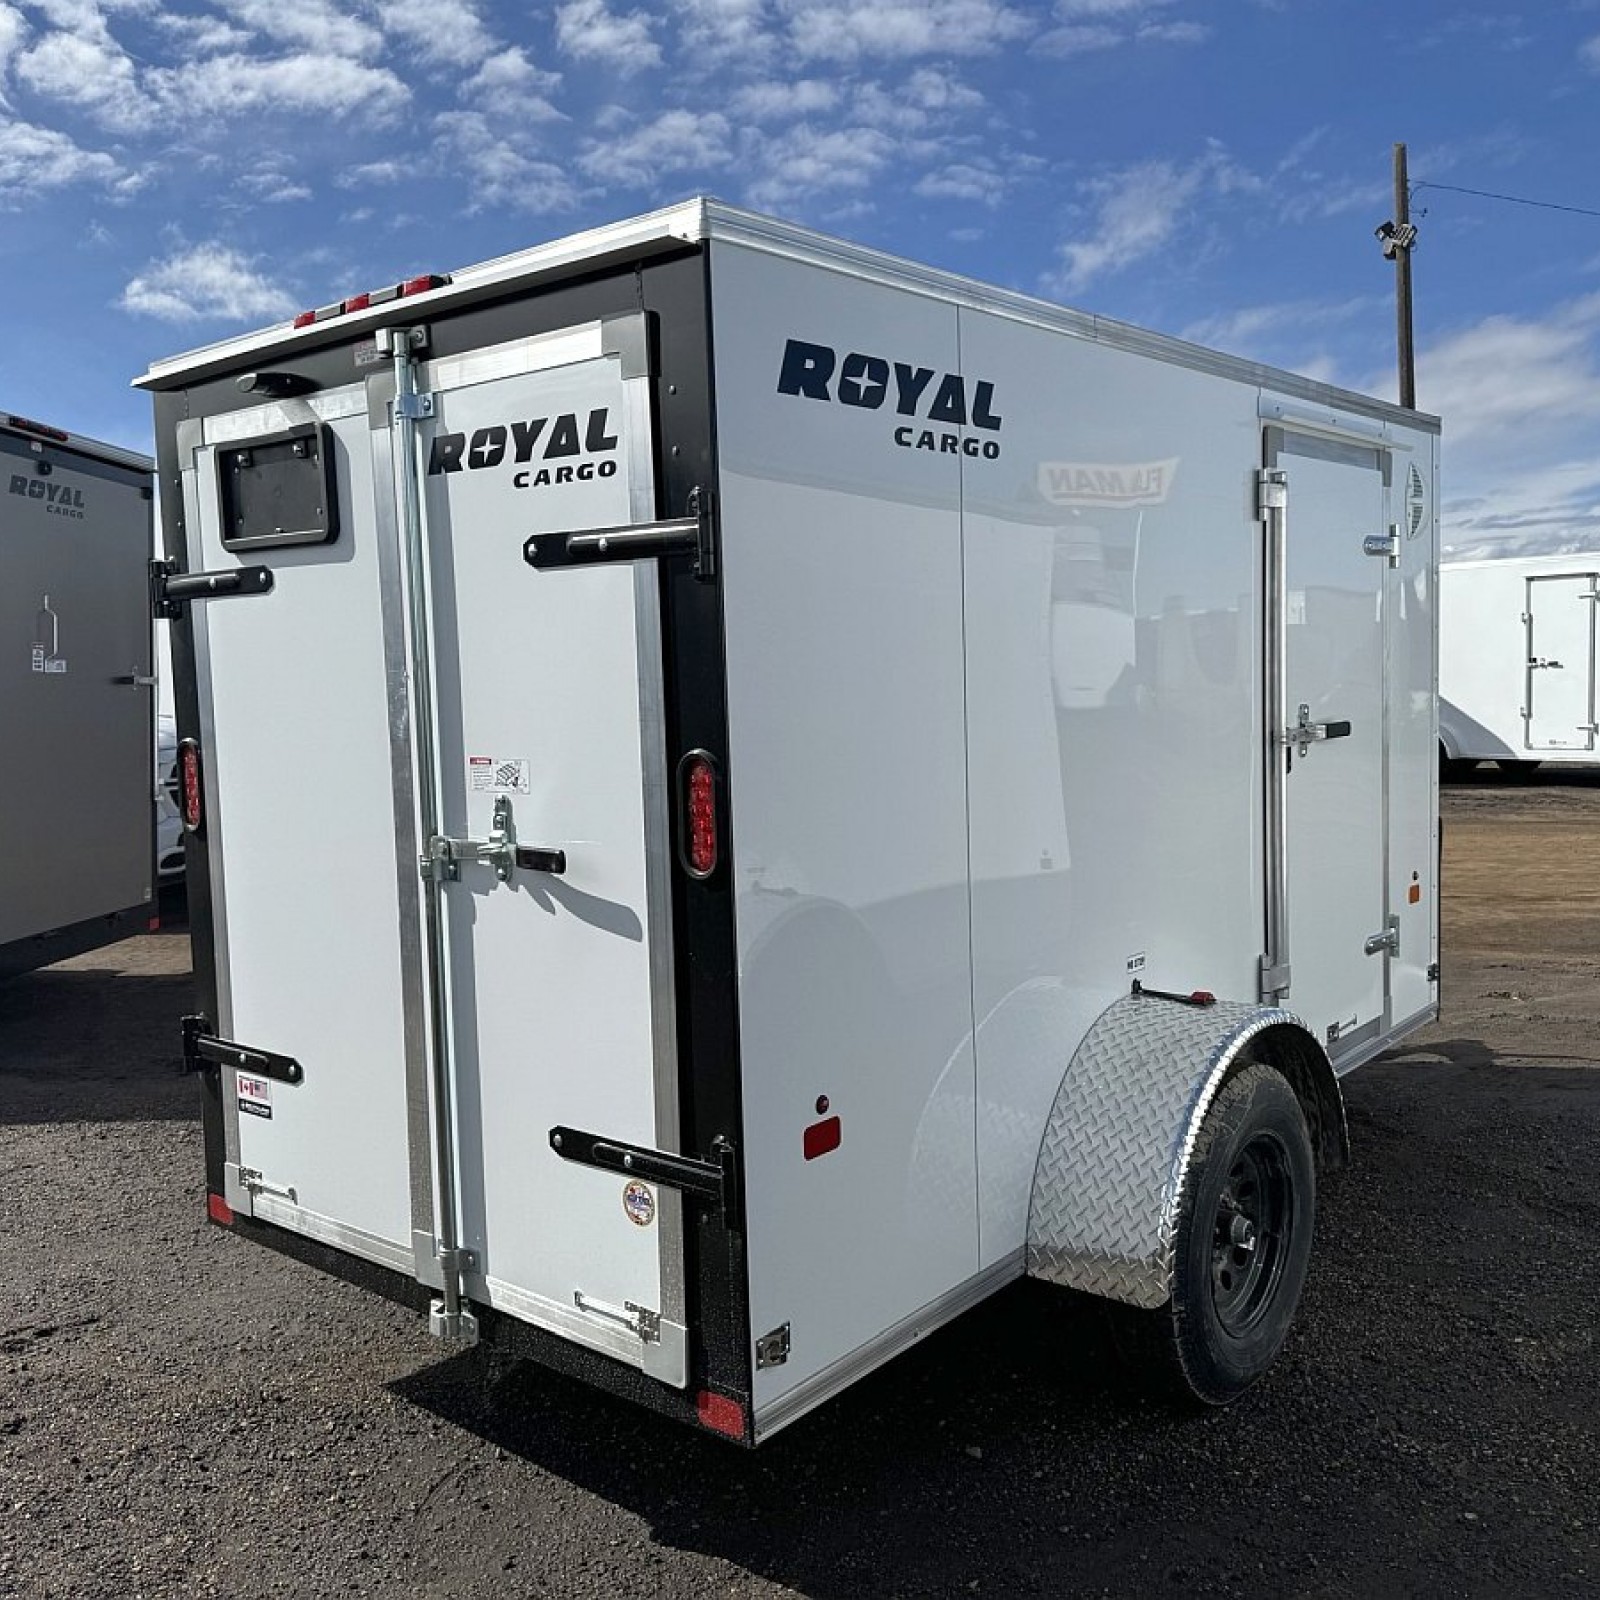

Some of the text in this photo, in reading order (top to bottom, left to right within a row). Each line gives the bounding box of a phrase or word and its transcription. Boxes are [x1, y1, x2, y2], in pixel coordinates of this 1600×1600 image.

[776, 339, 1002, 431] ROYAL
[428, 407, 618, 475] ROYAL
[894, 427, 1000, 460] CARGO
[9, 474, 85, 508] ROYAL
[513, 460, 617, 489] CARGO
[46, 505, 84, 519] CARGO
